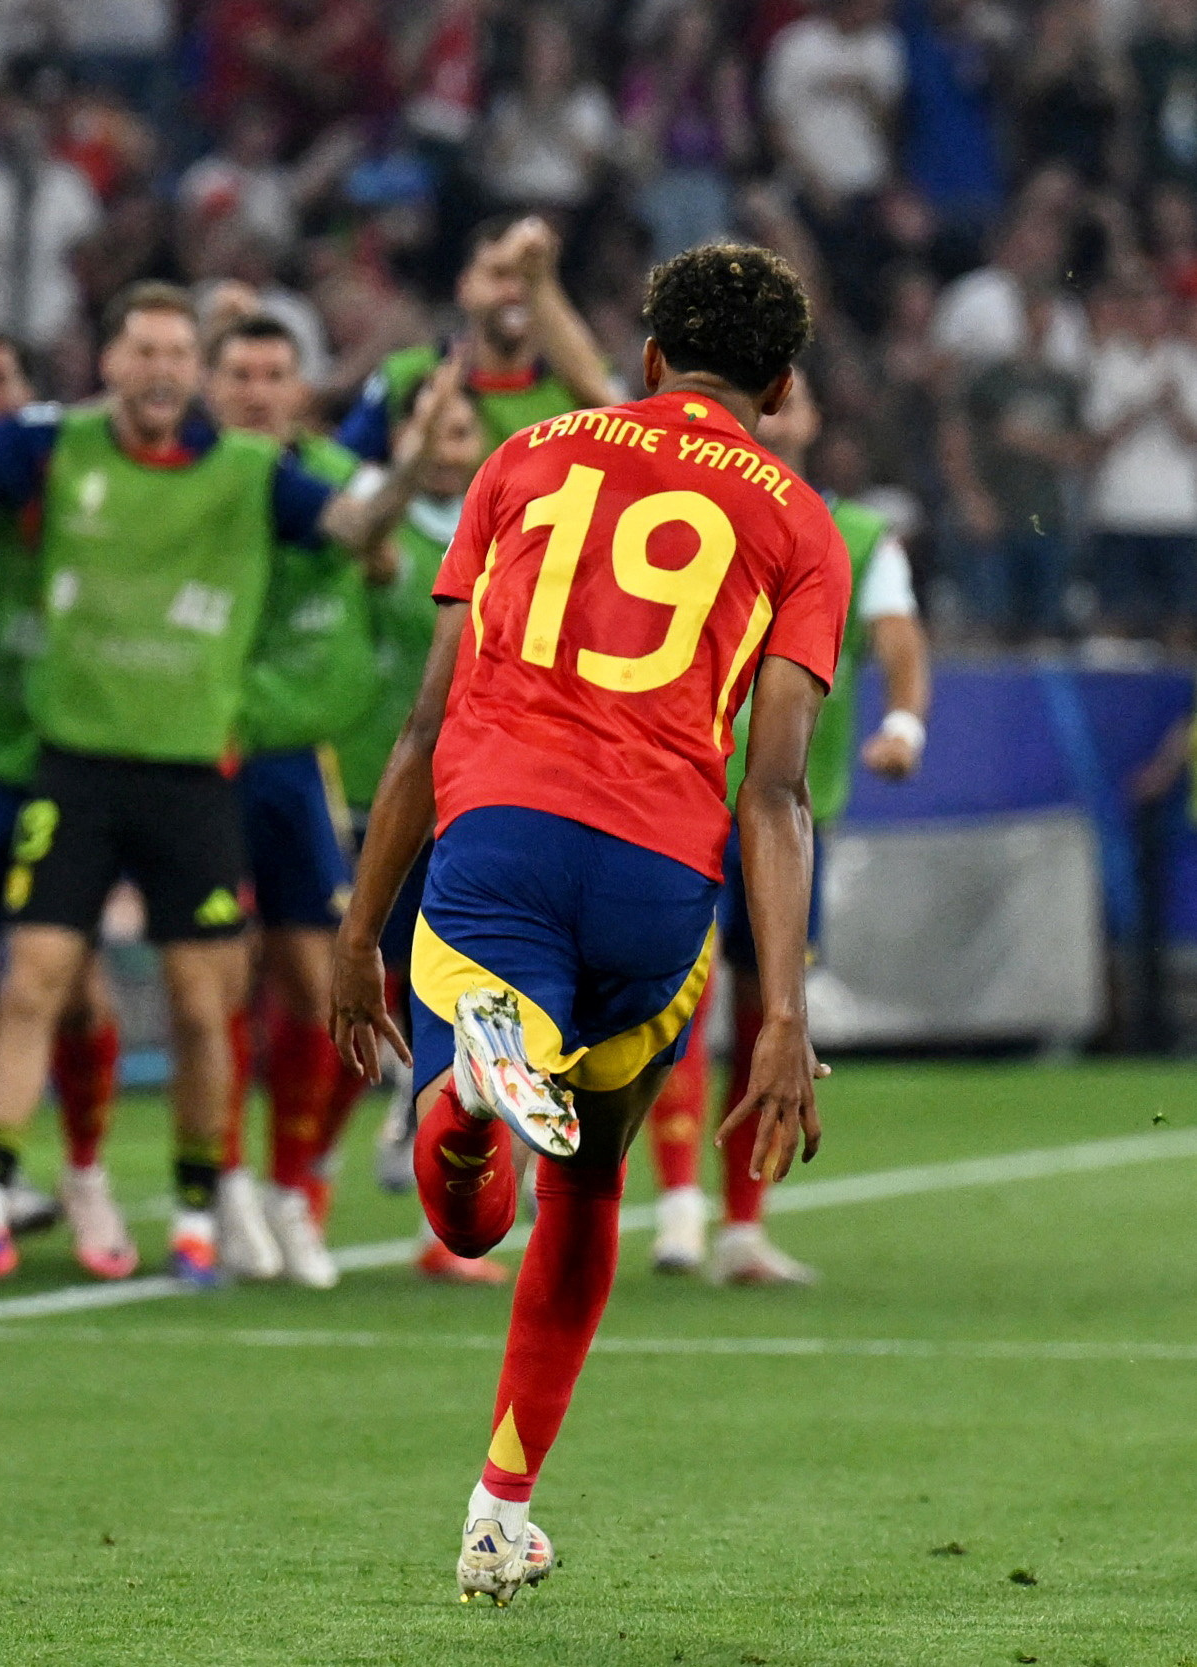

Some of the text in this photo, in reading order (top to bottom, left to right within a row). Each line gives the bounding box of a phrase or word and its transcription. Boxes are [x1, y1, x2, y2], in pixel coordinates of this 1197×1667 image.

[528, 411, 793, 506] LAMINE YAMAL
[521, 463, 737, 693] 19
